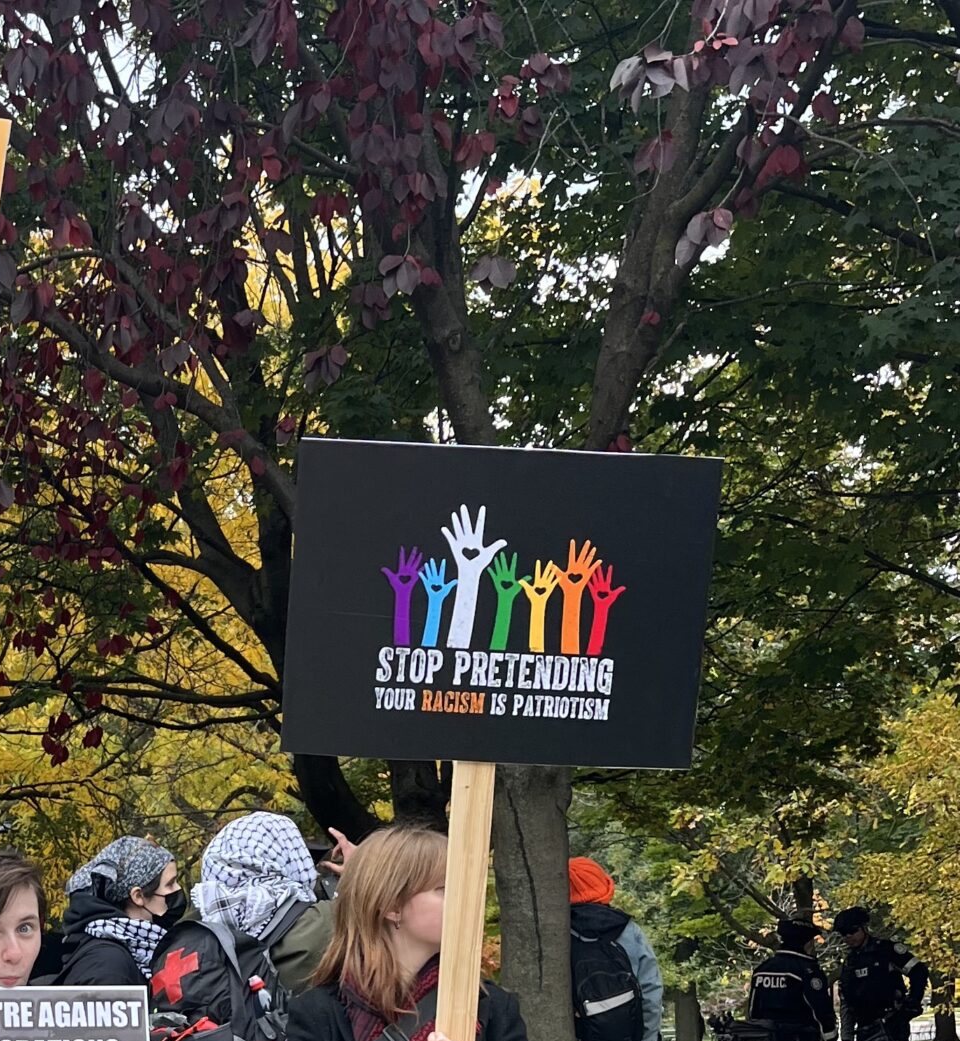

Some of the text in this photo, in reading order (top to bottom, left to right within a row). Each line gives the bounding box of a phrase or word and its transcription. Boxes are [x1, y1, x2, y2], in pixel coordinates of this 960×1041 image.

[375, 646, 615, 696] STOP PRETENDING
[374, 687, 611, 721] YOUR RACISM IS PATRIOTISM
[755, 976, 787, 989] POLIC
[38, 1000, 142, 1028] AGAINST
